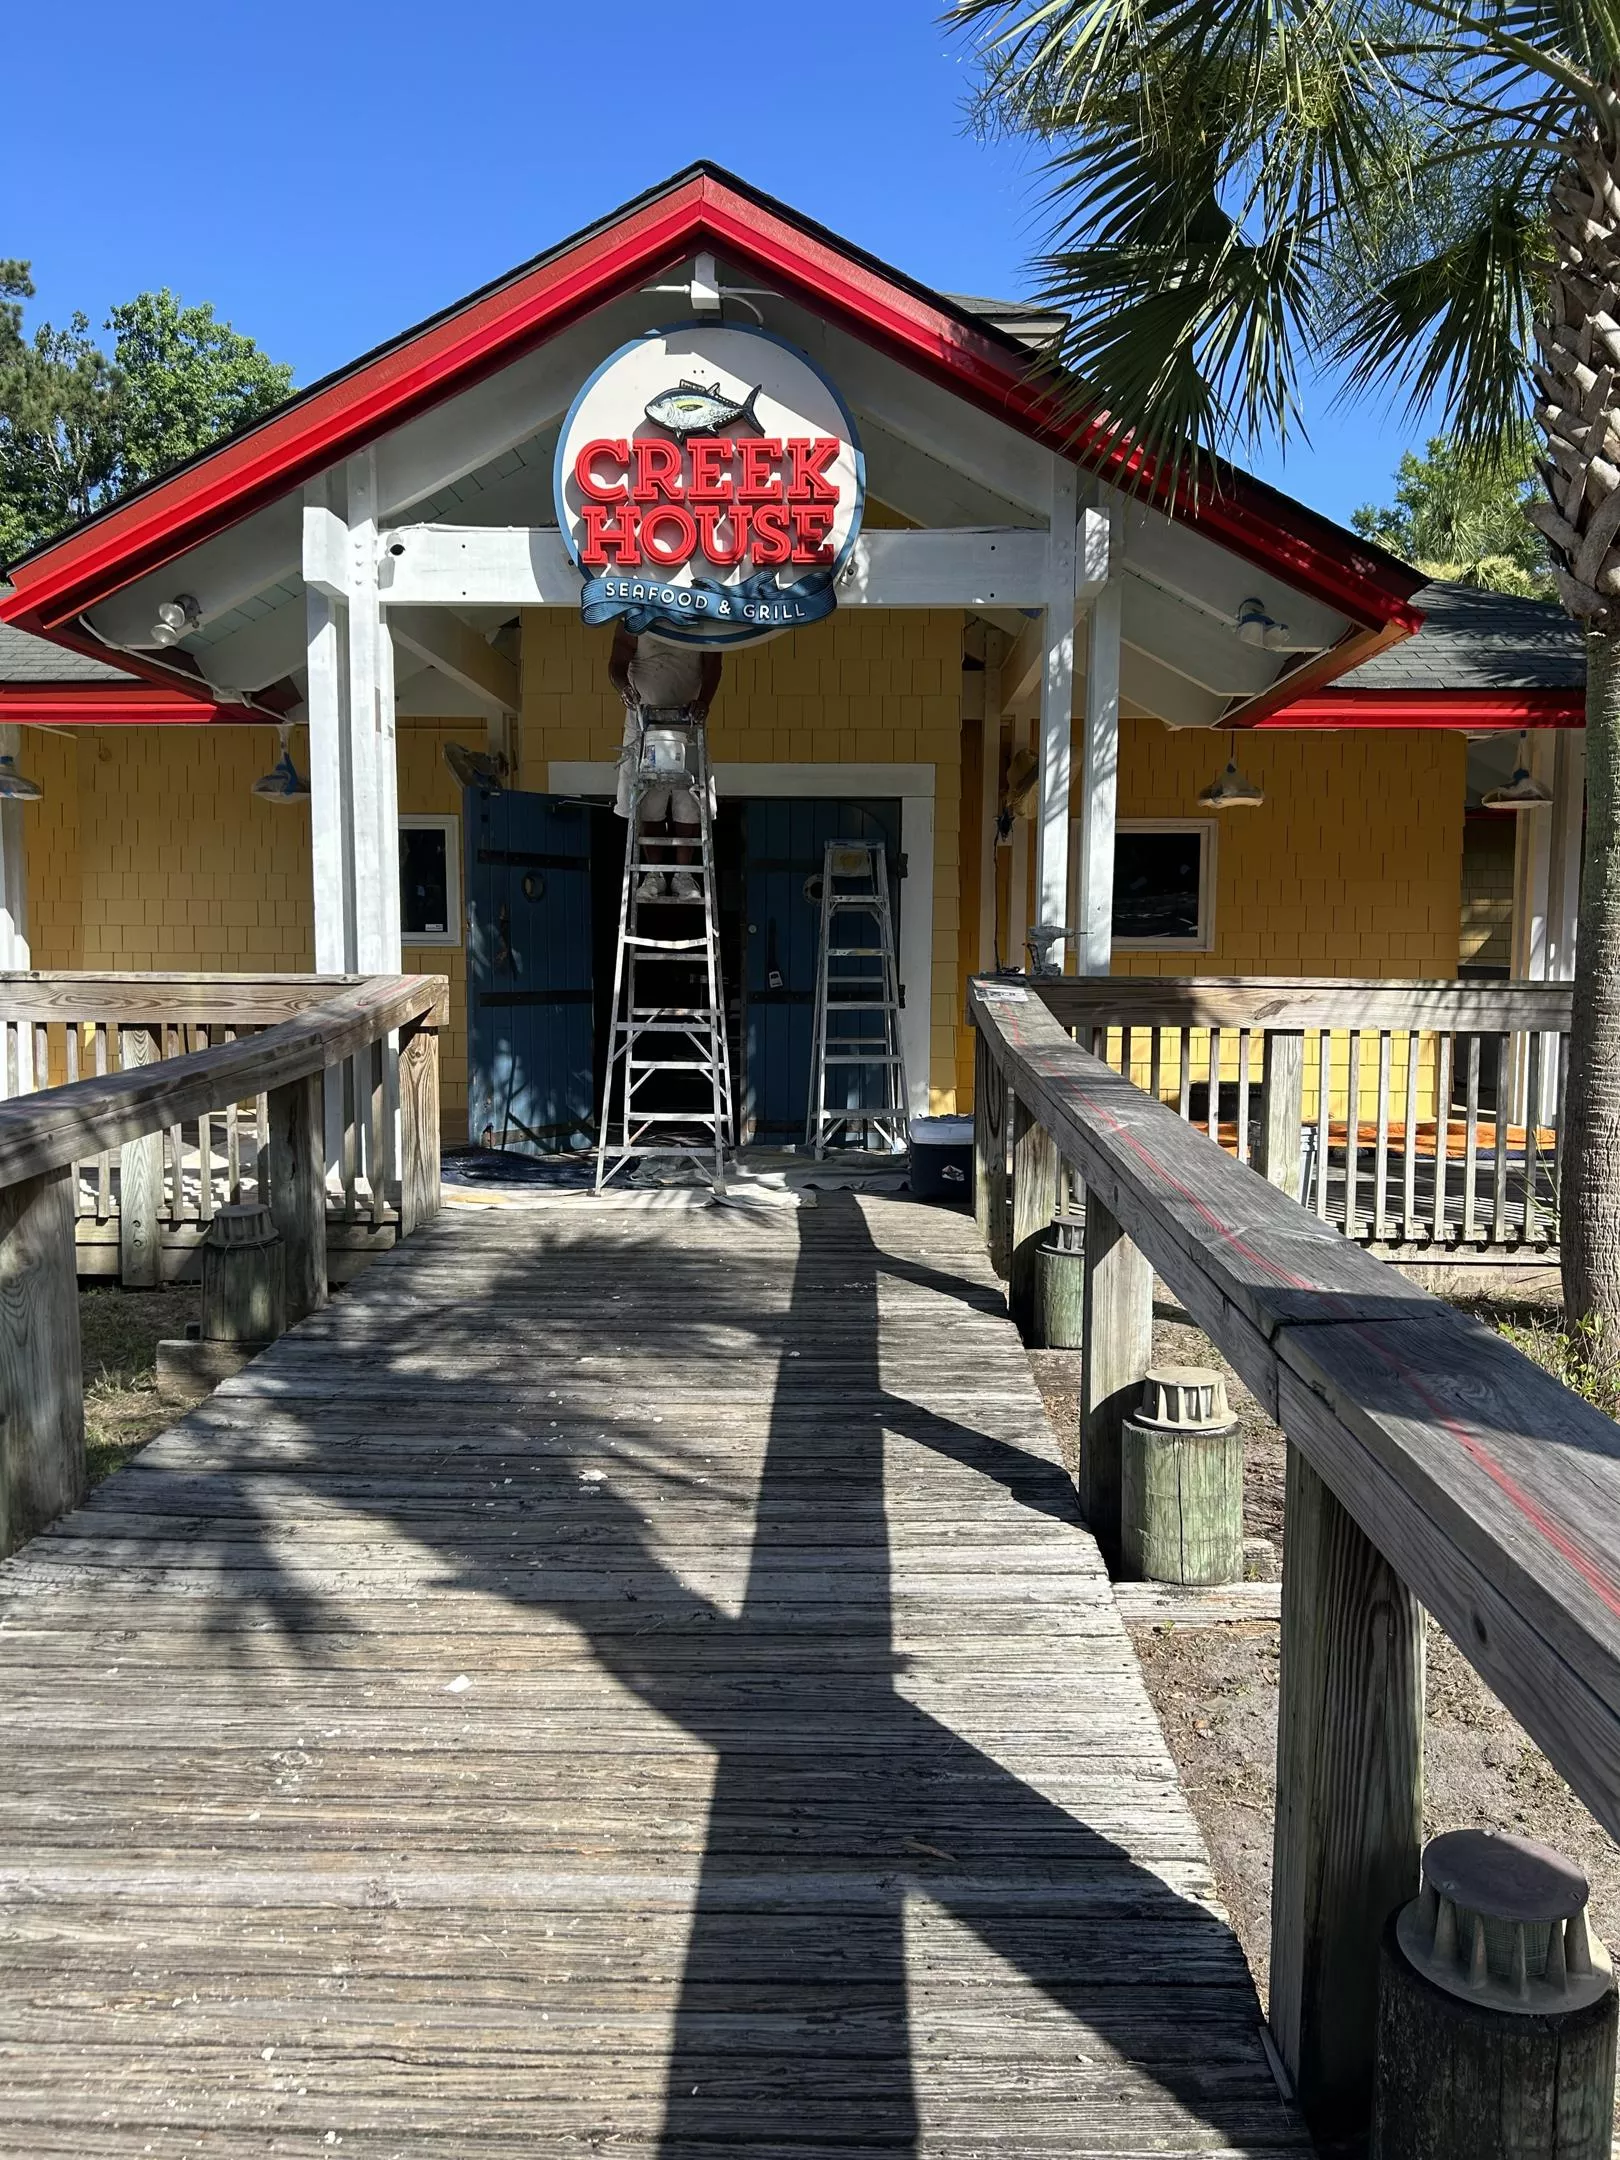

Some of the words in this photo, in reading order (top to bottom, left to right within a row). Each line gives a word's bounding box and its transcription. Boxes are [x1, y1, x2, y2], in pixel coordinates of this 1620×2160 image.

[575, 437, 840, 503] CREEK
[580, 504, 835, 567] HOUSE
[606, 582, 708, 609] SEAFOOD
[719, 600, 731, 615] &
[743, 603, 806, 619] GRILL
